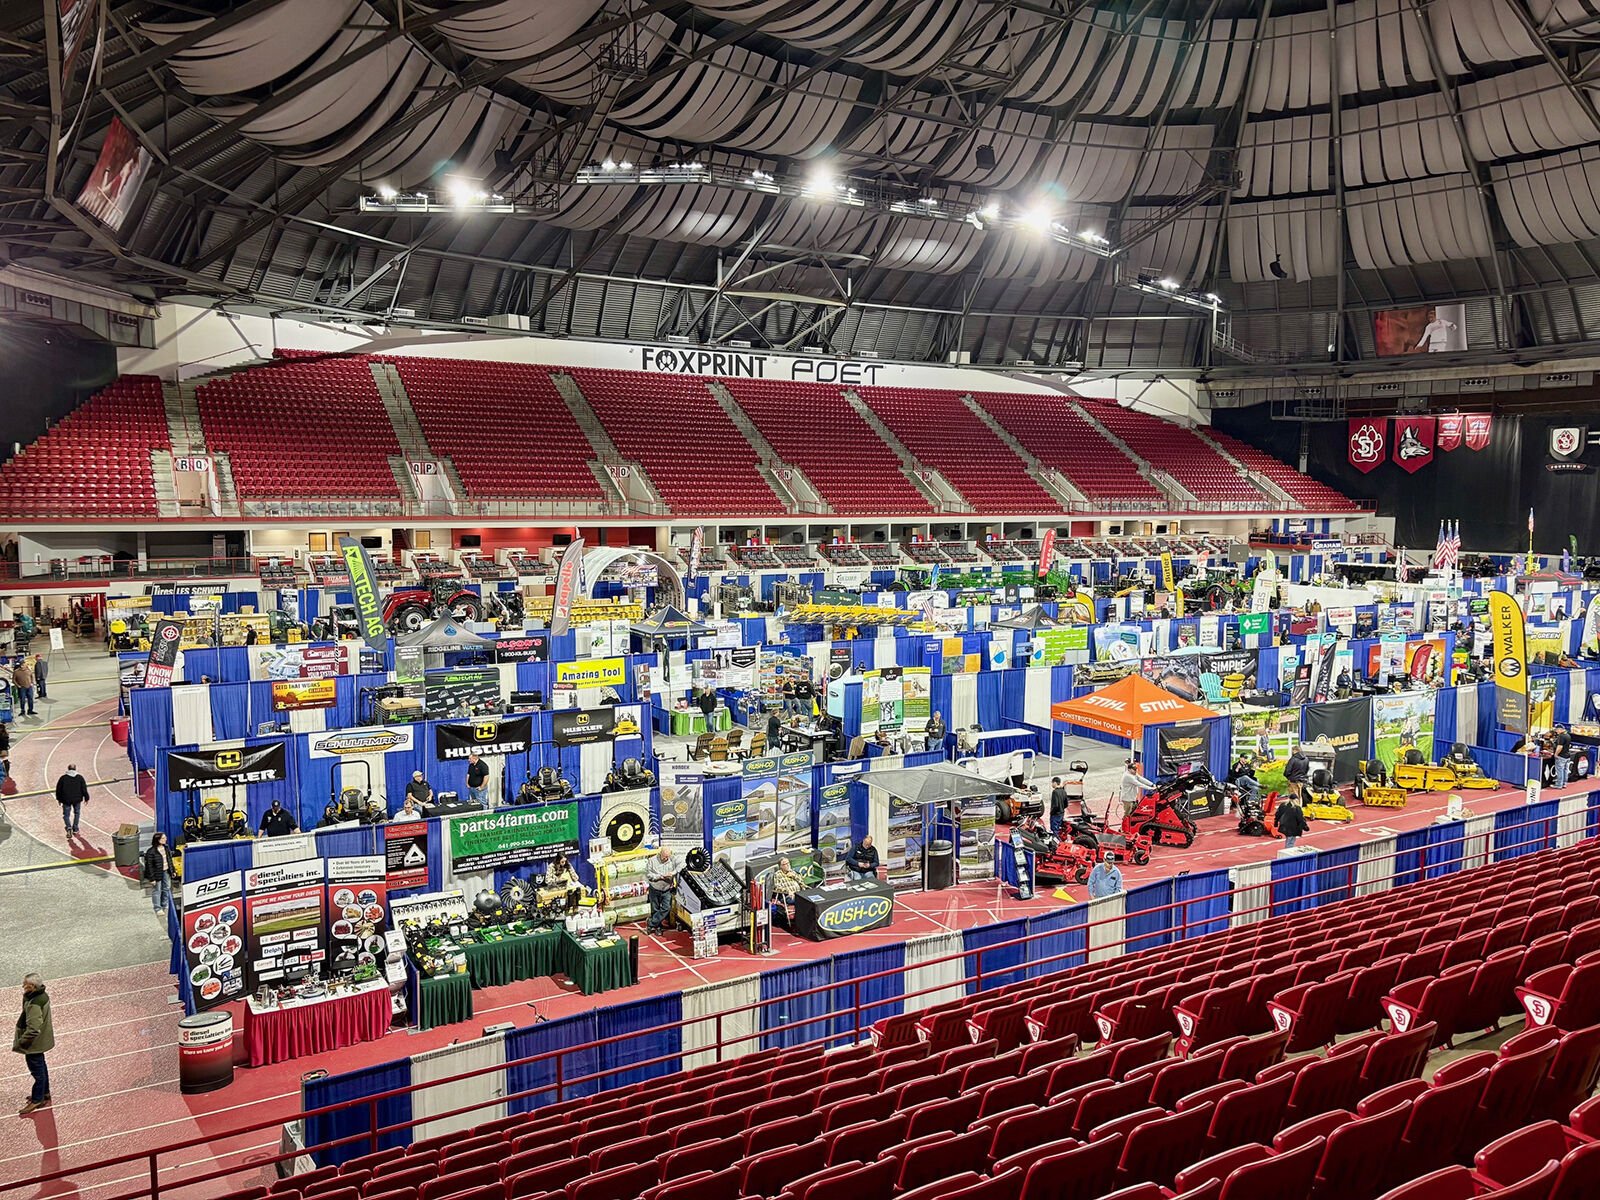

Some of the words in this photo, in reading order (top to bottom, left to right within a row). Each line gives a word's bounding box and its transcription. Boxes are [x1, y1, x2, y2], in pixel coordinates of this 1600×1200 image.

[642, 348, 767, 378] FOXPRINT
[792, 360, 884, 385] POET
[181, 460, 187, 469] R
[196, 460, 202, 469] Q
[426, 464, 432, 473] P
[364, 617, 384, 638] AG
[1502, 605, 1513, 656] WALKER
[148, 664, 173, 678] KNOW
[1210, 659, 1247, 673] SIMPLE
[146, 675, 171, 687] YOUR
[562, 670, 600, 681] Amazing
[602, 667, 621, 677] Tool
[1084, 695, 1127, 712] STIHL
[1139, 699, 1185, 713] STIHL
[1060, 711, 1102, 727] CONSTRUCTION
[1103, 720, 1122, 732] TOOLS
[563, 725, 603, 734] HUSTLER
[1329, 733, 1359, 746] WALKER
[445, 741, 525, 758] HUSTLER
[748, 761, 774, 770] RUSH-CO
[784, 754, 810, 765] RUSH-CO
[719, 804, 743, 815] RUSH-CO
[459, 809, 569, 837] parts4farm.com
[257, 868, 284, 879] diesel
[257, 872, 304, 885] specialties
[306, 869, 321, 877] inc.
[196, 878, 230, 895] ADS
[824, 900, 889, 926] RUSH-CO
[270, 933, 289, 941] BOSCH
[264, 946, 283, 955] Delphi
